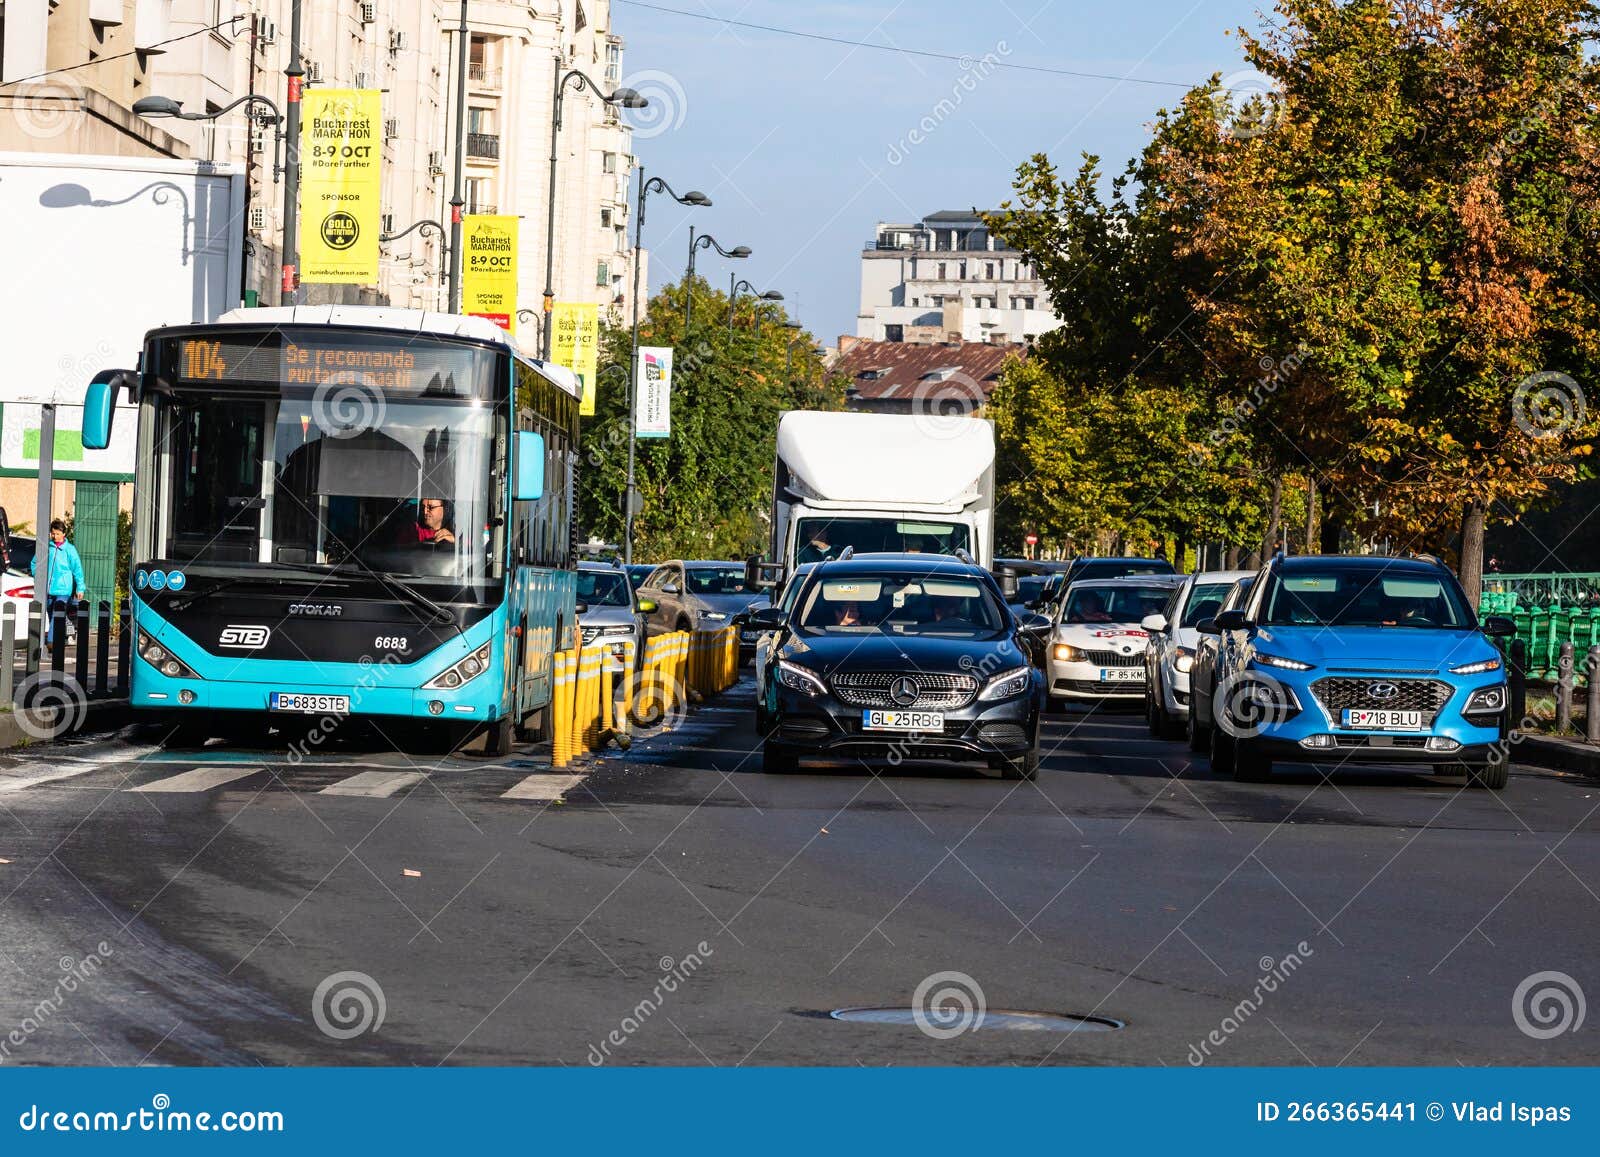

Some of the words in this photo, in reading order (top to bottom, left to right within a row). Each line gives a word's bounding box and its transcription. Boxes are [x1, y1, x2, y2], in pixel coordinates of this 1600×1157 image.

[313, 118, 370, 129] Bucharest
[313, 128, 371, 139] MARATHON
[313, 145, 336, 157] 8-9
[341, 146, 371, 158] OCT
[312, 160, 370, 168] #DareFurther
[328, 219, 353, 229] GOLD
[470, 235, 511, 245] Bucharest
[470, 244, 511, 252] MARATHON
[471, 256, 487, 265] 8-9
[490, 256, 511, 266] OCT
[184, 340, 226, 379] 104
[286, 344, 309, 363] Se
[315, 349, 415, 369] recomanda
[288, 604, 342, 616] OTOKAR
[219, 629, 265, 644] STB
[375, 636, 407, 649] 6683
[1119, 671, 1128, 679] 85
[871, 712, 888, 725] GL
[1351, 711, 1360, 724] B
[1367, 712, 1386, 725] 718
[1391, 712, 1418, 725] BLU
